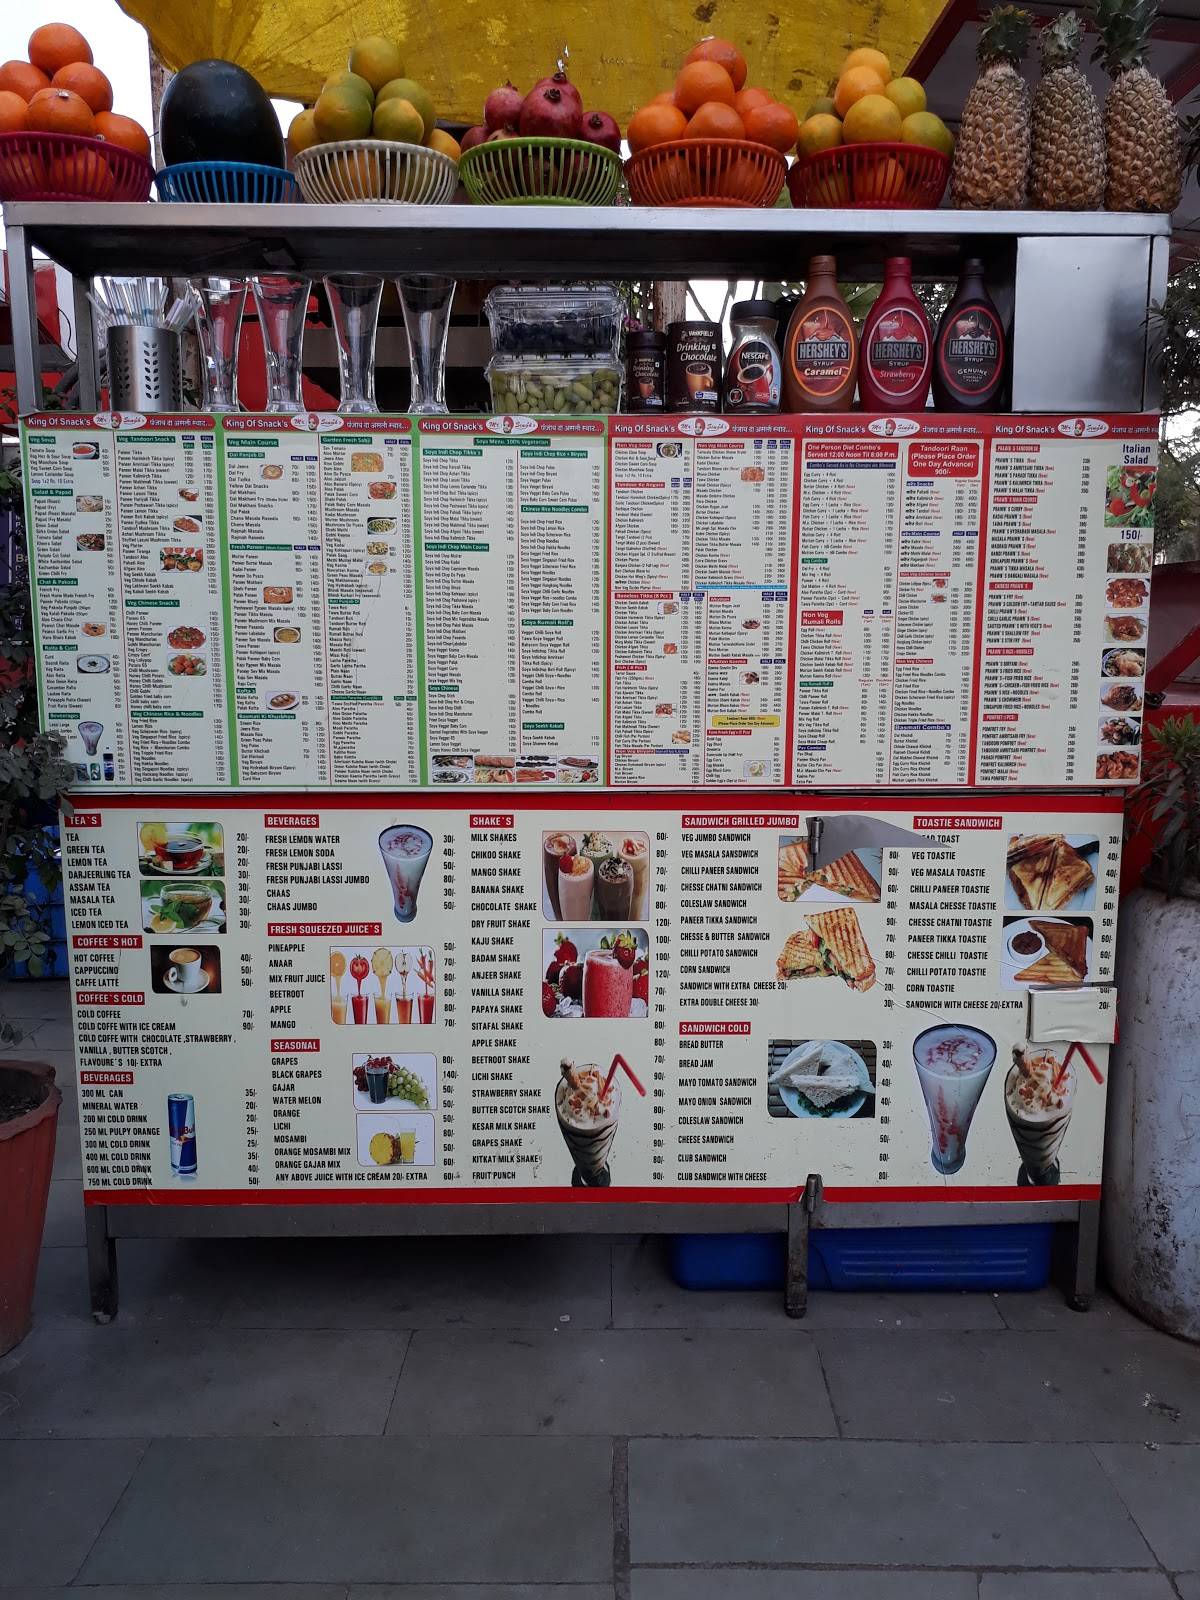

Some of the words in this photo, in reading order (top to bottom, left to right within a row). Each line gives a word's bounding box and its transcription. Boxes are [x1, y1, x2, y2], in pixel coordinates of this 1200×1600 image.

[677, 342, 711, 352] Drinking
[799, 344, 847, 358] HERSHEY'S
[875, 343, 922, 359] HERSHEY'S
[952, 341, 994, 356] HERSHEY'S
[680, 353, 717, 362] Chocolate
[804, 368, 842, 376] Caramel
[880, 371, 916, 379] Strawberry
[28, 417, 48, 426] King
[49, 417, 59, 426] Of
[60, 417, 91, 426] Snack's
[226, 418, 245, 428] King
[247, 418, 256, 427] Of
[258, 418, 288, 427] Snack's
[422, 422, 442, 431] King
[444, 421, 453, 430] Of
[454, 422, 483, 431] Snack's
[615, 424, 633, 434] King
[634, 424, 644, 432] Of
[645, 424, 675, 433] Snack's
[805, 425, 825, 434] King
[826, 425, 836, 433] Of
[837, 425, 866, 433] Snack's
[995, 425, 1013, 434] King
[1014, 425, 1025, 433] Of
[1026, 425, 1055, 433] Snack's
[1123, 444, 1151, 453] Italian
[1124, 455, 1149, 464] Salad
[929, 461, 942, 469] Day
[1120, 530, 1143, 540] 150/-
[267, 817, 317, 826] BEVERAGES
[684, 817, 729, 826] SANDWICH
[731, 817, 764, 826] GRILLED
[767, 817, 797, 826] JUMBO
[917, 818, 952, 827] TOASTIE
[954, 818, 999, 827] SANDWICH
[265, 836, 287, 844] FRESH
[289, 836, 313, 844] LEMON
[315, 835, 340, 844] WATER
[471, 833, 488, 842] MILK
[490, 833, 517, 842] SHAKES
[67, 846, 90, 854] GREEN
[92, 846, 105, 854] TEA
[237, 846, 250, 854] 20/-
[68, 858, 92, 866] LEMON
[94, 858, 107, 866] TEA
[238, 858, 250, 867] 20/-
[681, 866, 700, 875] CHILLI
[701, 866, 725, 875] PANEER
[726, 866, 759, 875] SANDWICH
[911, 868, 924, 877] VEG
[925, 868, 955, 877] MASALA
[957, 868, 986, 877] TOASTIE
[70, 896, 100, 904] MASALA
[102, 896, 115, 904] TEA
[471, 903, 511, 911] CHOCOLATE
[514, 903, 537, 911] SHAKE
[270, 925, 297, 934] FRESH
[299, 925, 342, 934] SQUEEZED
[121, 937, 138, 946] HOT
[268, 944, 305, 952] PINEAPPLE
[74, 966, 119, 975] CAPPUCCINO
[906, 1000, 943, 1009] SANDWICH
[944, 1000, 962, 1009] WITH
[963, 1000, 988, 1009] CHEESE
[77, 1010, 95, 1018] COLD
[97, 1010, 121, 1018] COFFEE
[681, 1024, 726, 1033] SANDWICH
[728, 1024, 749, 1033] COLD
[274, 1041, 317, 1050] SEASONAL
[679, 1041, 699, 1049] BREAD
[700, 1040, 724, 1049] BUTTER
[83, 1074, 131, 1082] BEVERAGES
[272, 1070, 294, 1079] BLACK
[295, 1070, 322, 1079] GRAPES
[472, 1089, 517, 1097] STRAWBERRY
[519, 1089, 542, 1097] SHAKE
[273, 1096, 297, 1105] WATER
[298, 1096, 322, 1105] MELON
[83, 1102, 112, 1110] MINERAL
[114, 1102, 138, 1110] WATER
[84, 1128, 96, 1136] 250
[98, 1128, 108, 1136] ML
[109, 1127, 131, 1136] PULPY
[133, 1127, 160, 1136] ORANGE
[678, 1173, 693, 1181] CLUB
[694, 1173, 727, 1181] SANDWICH
[728, 1173, 744, 1181] WITH
[744, 1172, 767, 1181] CHEESE
